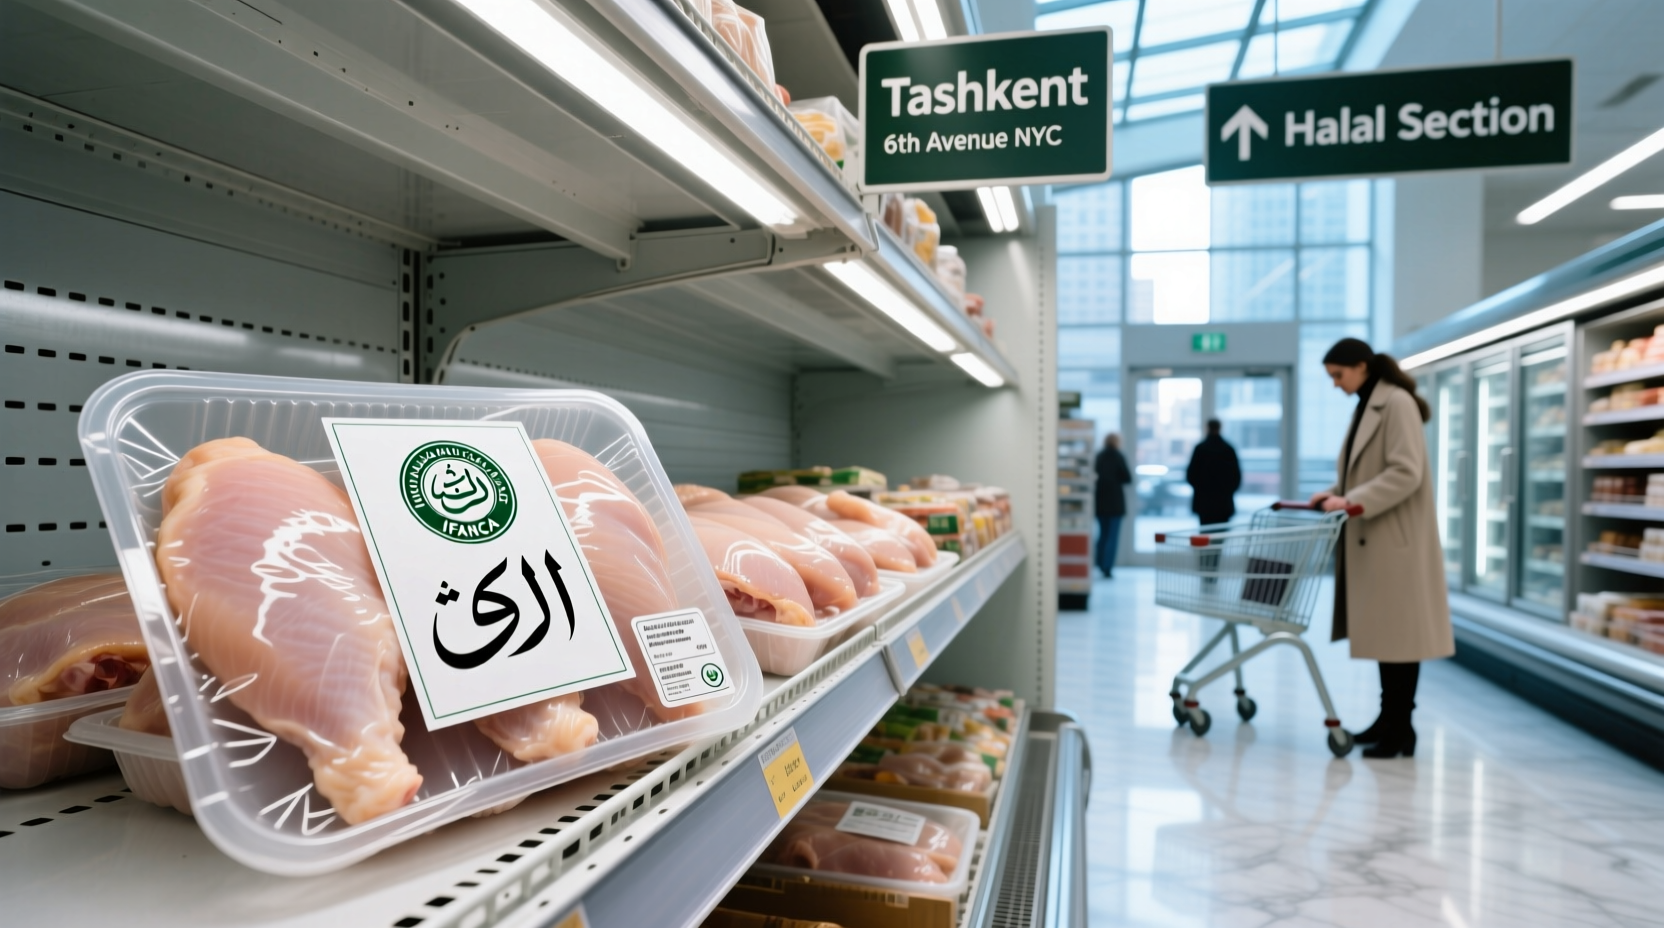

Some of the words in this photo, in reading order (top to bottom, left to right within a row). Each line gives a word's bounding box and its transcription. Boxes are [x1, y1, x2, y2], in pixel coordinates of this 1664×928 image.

[881, 67, 1089, 118] Tashkent
[883, 132, 921, 155] 6th
[926, 131, 1008, 153] Avenue
[1014, 125, 1062, 147] NYC
[1285, 104, 1386, 147] Halal
[1397, 96, 1555, 141] Section
[442, 517, 500, 538] IFANCA
